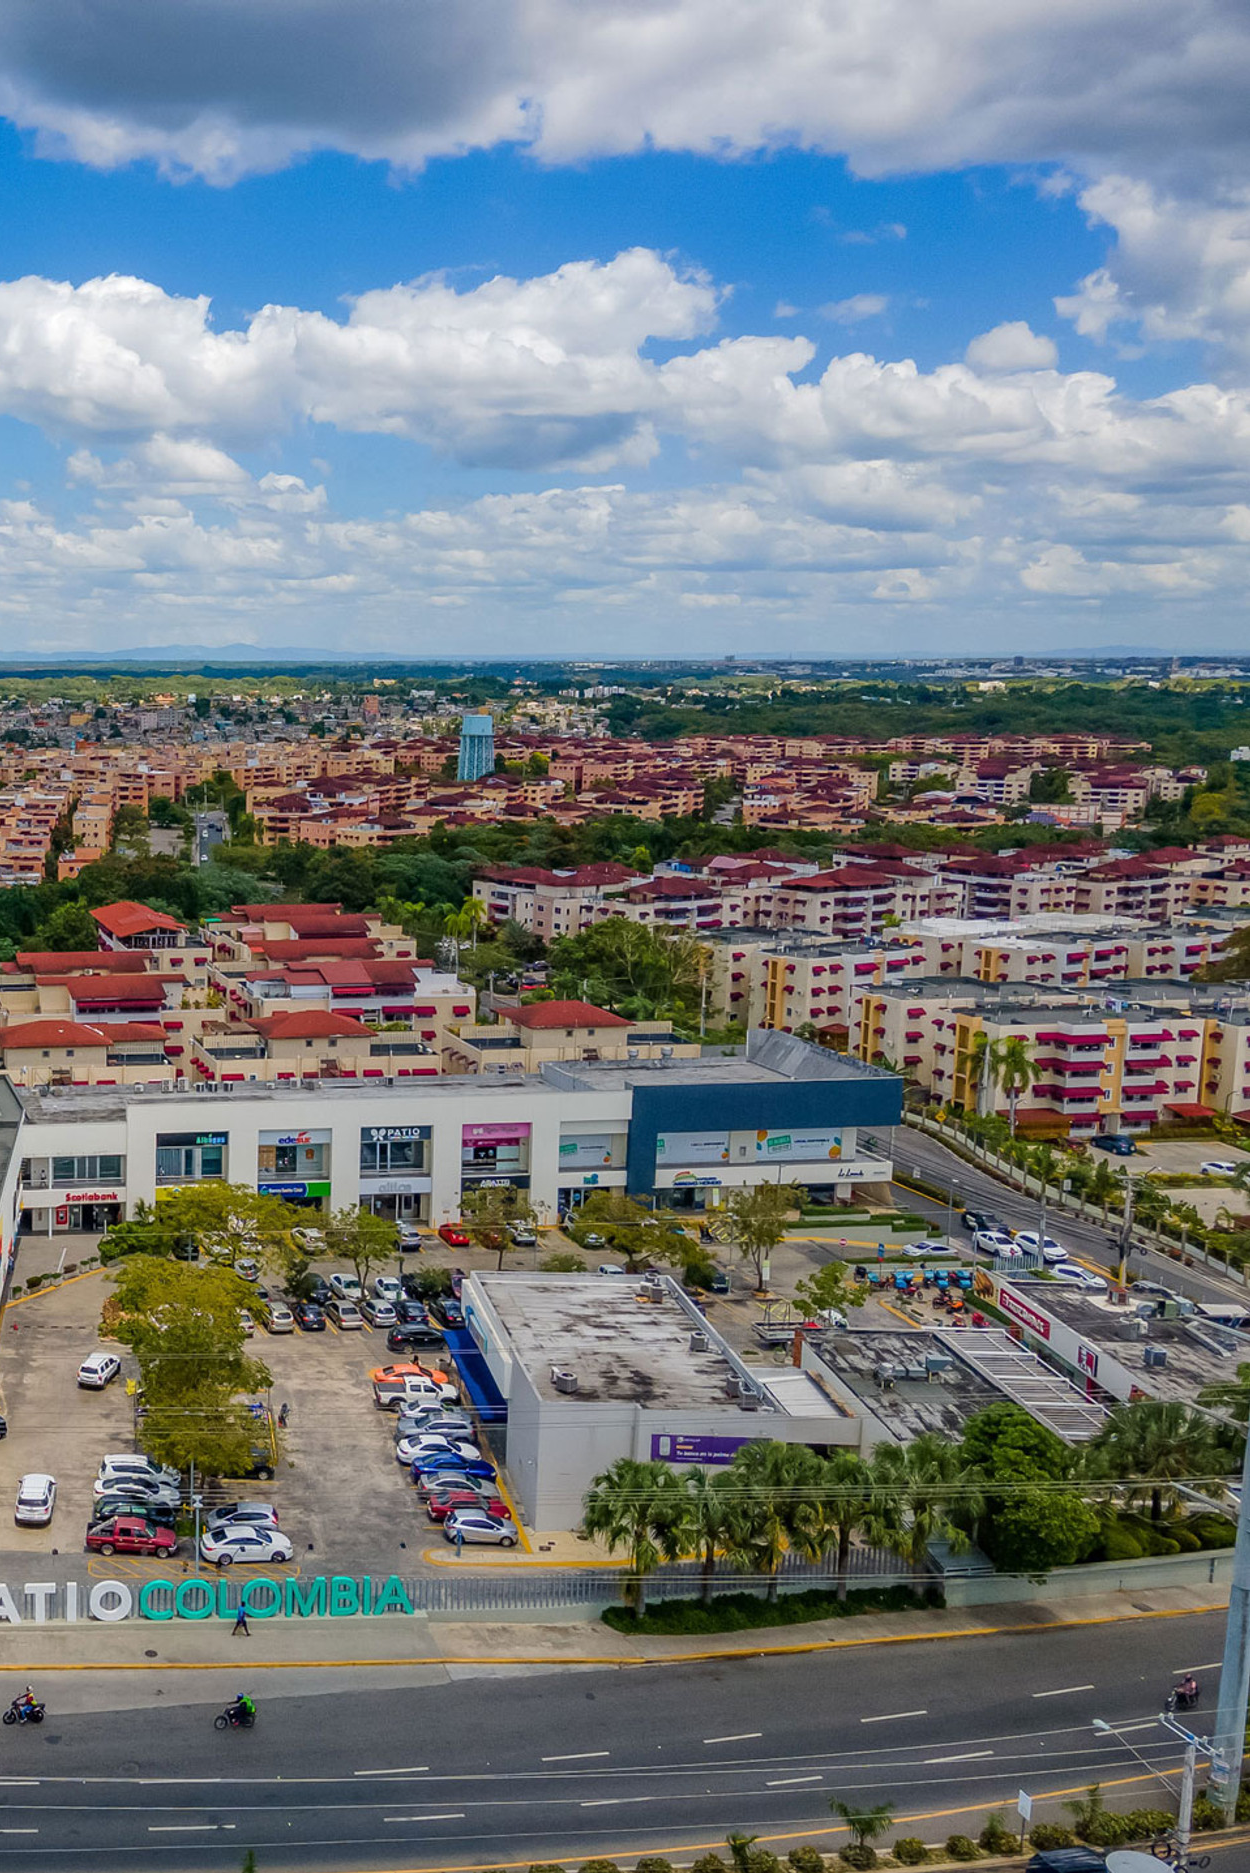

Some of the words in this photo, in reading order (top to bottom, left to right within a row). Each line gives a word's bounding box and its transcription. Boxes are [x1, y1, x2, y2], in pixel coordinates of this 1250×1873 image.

[387, 1127, 420, 1137] PATIO
[278, 1135, 312, 1144] edesur
[65, 1192, 119, 1202] Scotiabank
[139, 1575, 415, 1621] COLOMBIA
